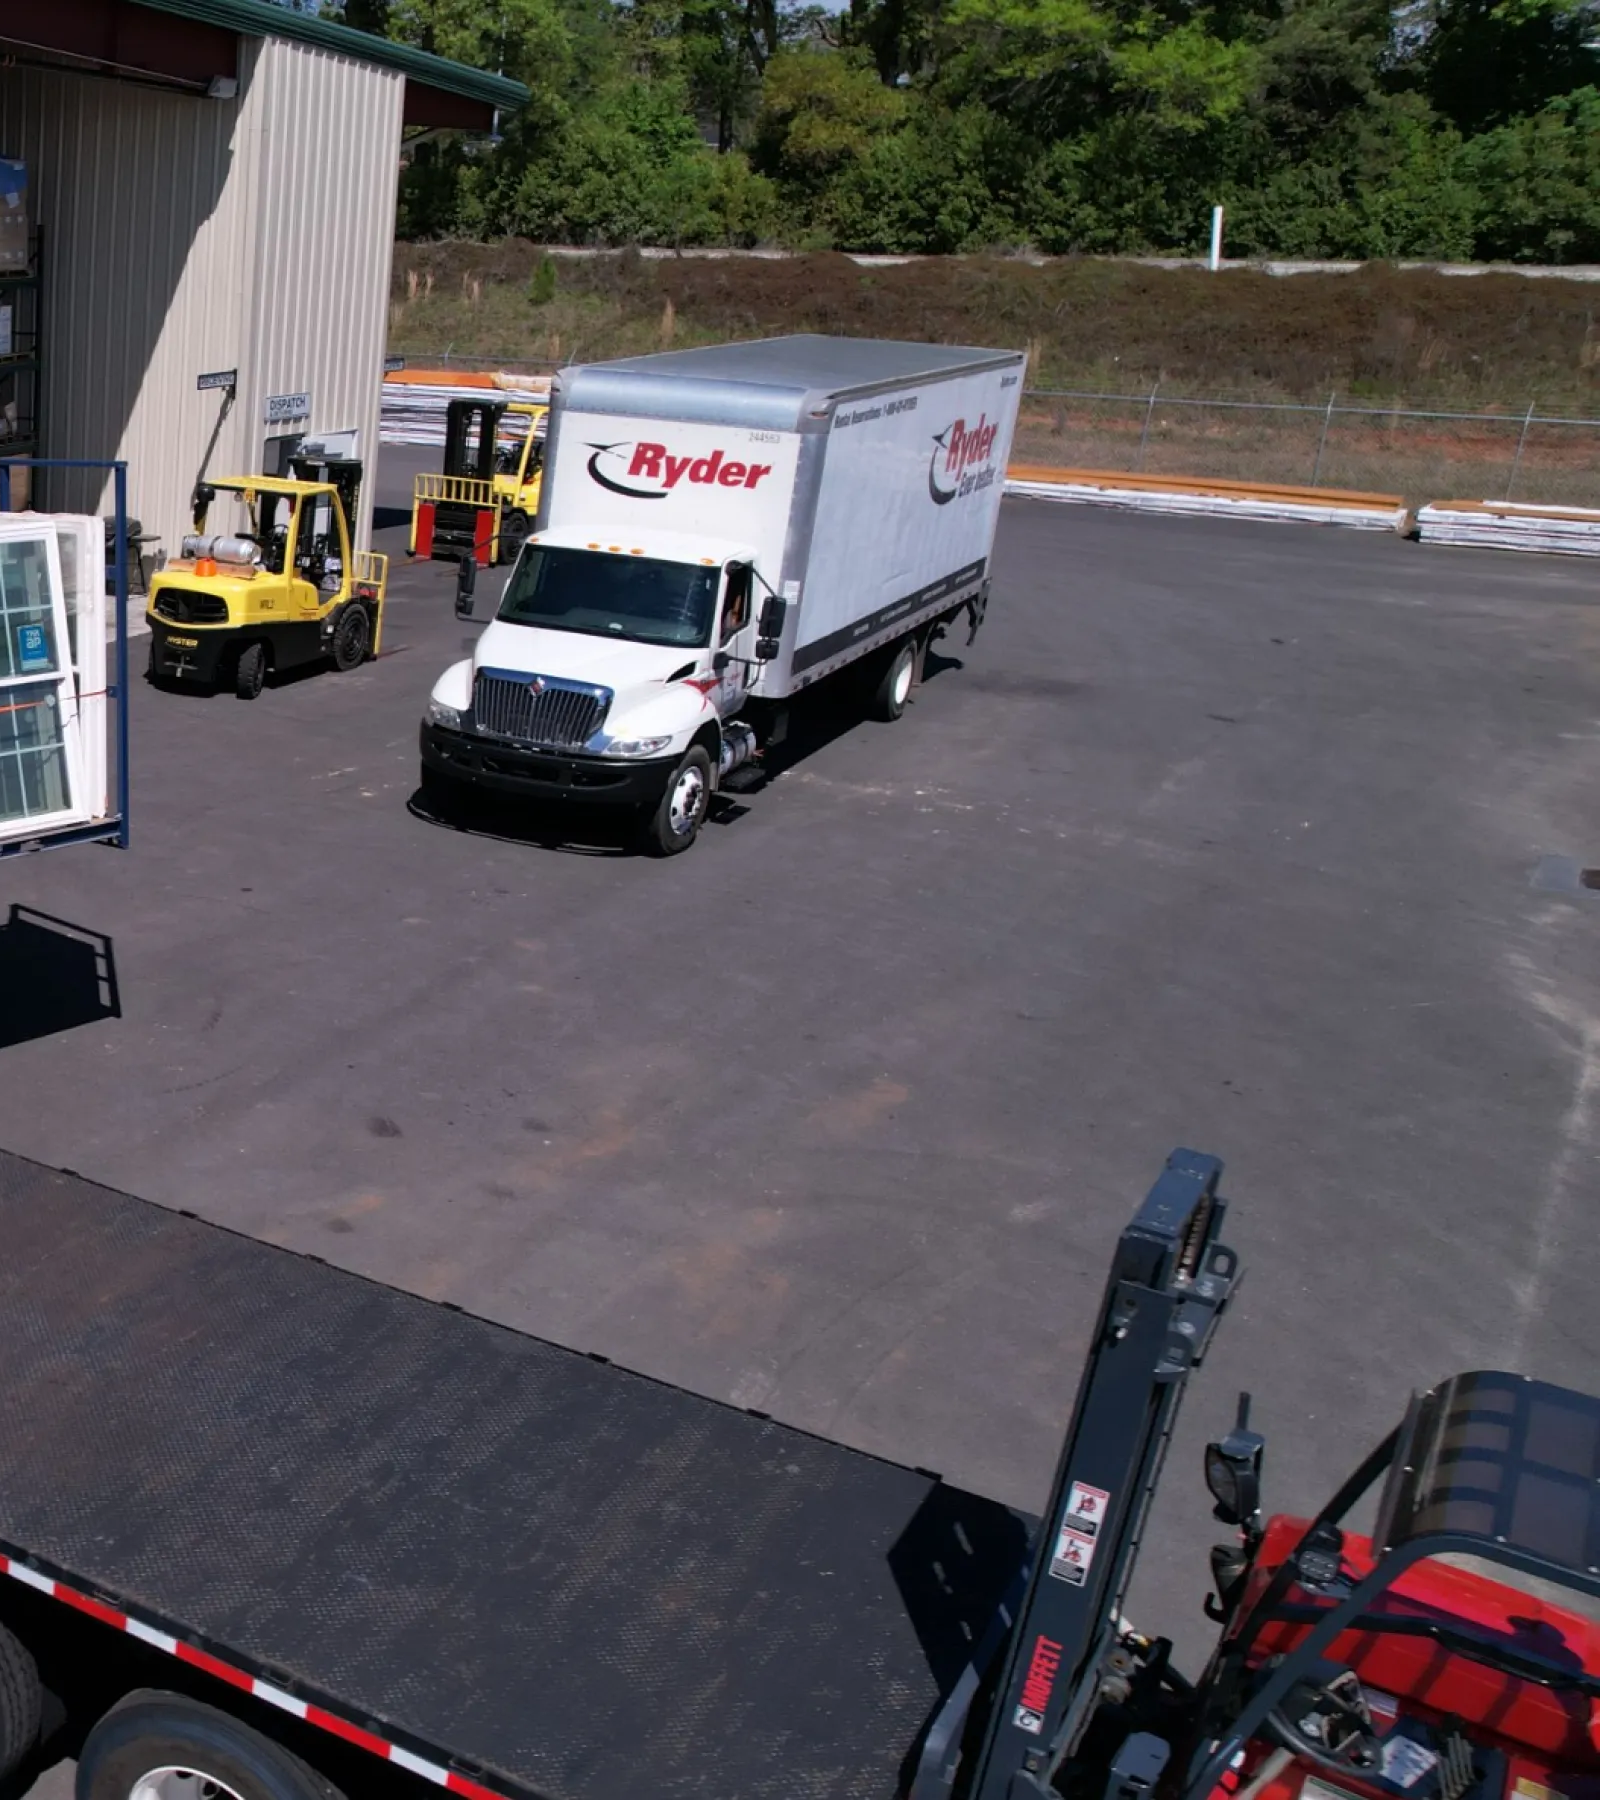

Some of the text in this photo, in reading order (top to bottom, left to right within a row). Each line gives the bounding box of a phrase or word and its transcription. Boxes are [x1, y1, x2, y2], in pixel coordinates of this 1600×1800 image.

[270, 396, 306, 411] DISPATCH
[627, 442, 772, 489] Ryder
[945, 412, 1000, 482] Ryder
[166, 636, 199, 649] HYSTER
[1020, 1635, 1063, 1712] MOFFETT
